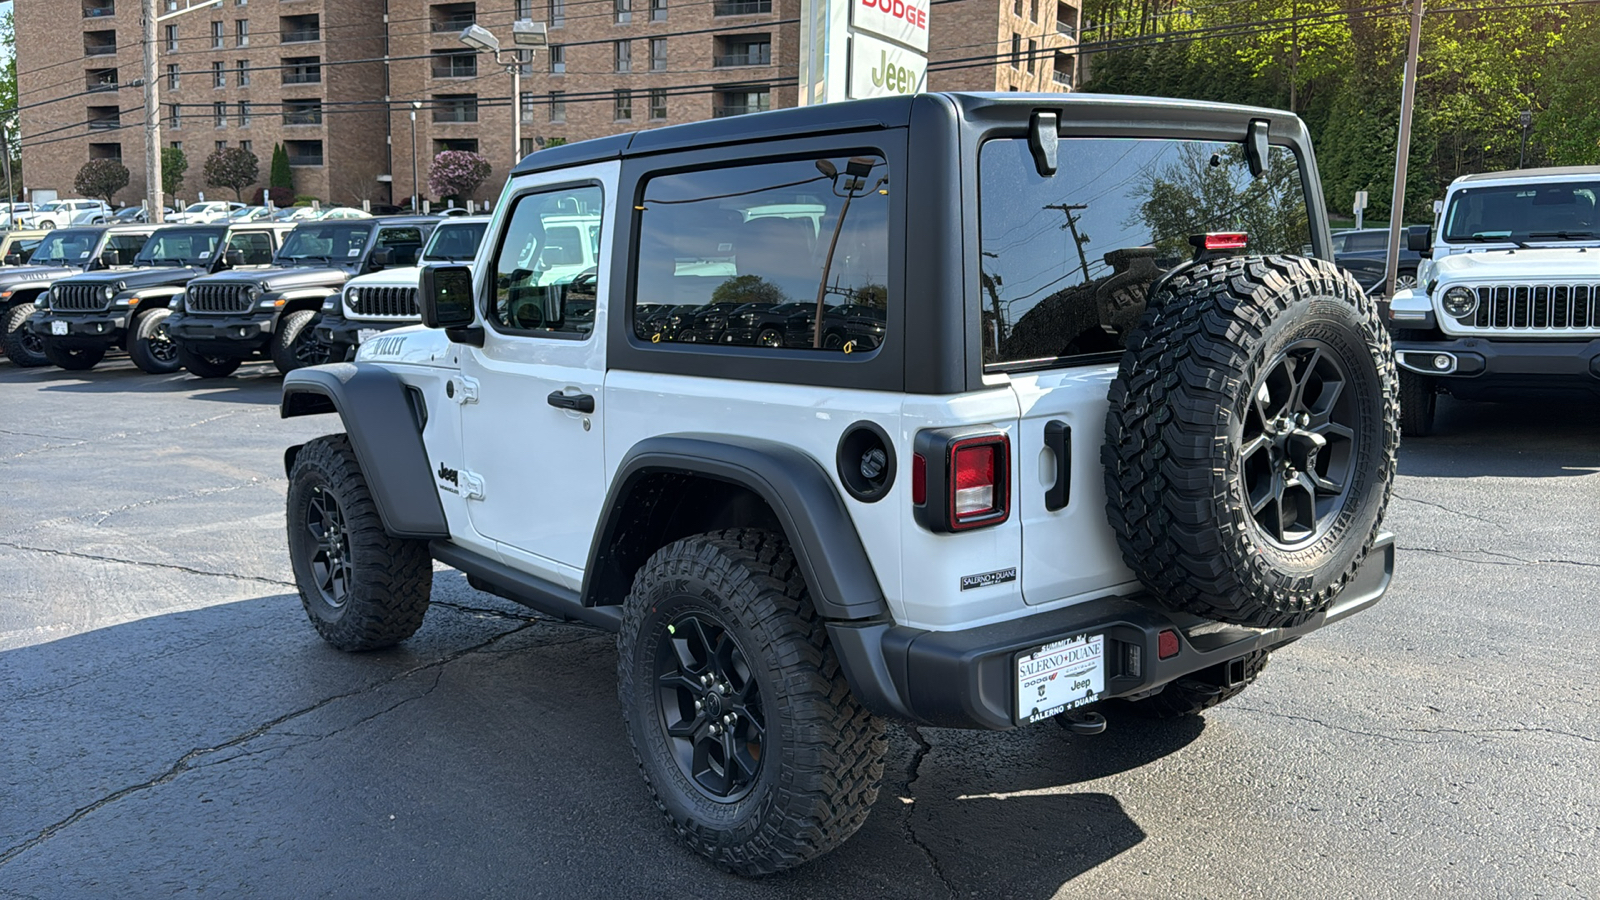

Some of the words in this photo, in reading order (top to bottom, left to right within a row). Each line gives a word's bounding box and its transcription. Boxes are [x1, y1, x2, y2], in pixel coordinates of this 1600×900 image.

[20, 272, 49, 280] WILLYS
[373, 336, 409, 356] WILLYS
[438, 462, 459, 487] Jeep
[963, 575, 990, 586] SALERNO
[995, 570, 1015, 580] DUANE
[1019, 655, 1063, 677] SALERNO
[1068, 643, 1101, 662] DUANE
[1071, 679, 1091, 691] Jeep
[1029, 705, 1064, 723] SALERNO
[1074, 693, 1099, 708] DUANE
